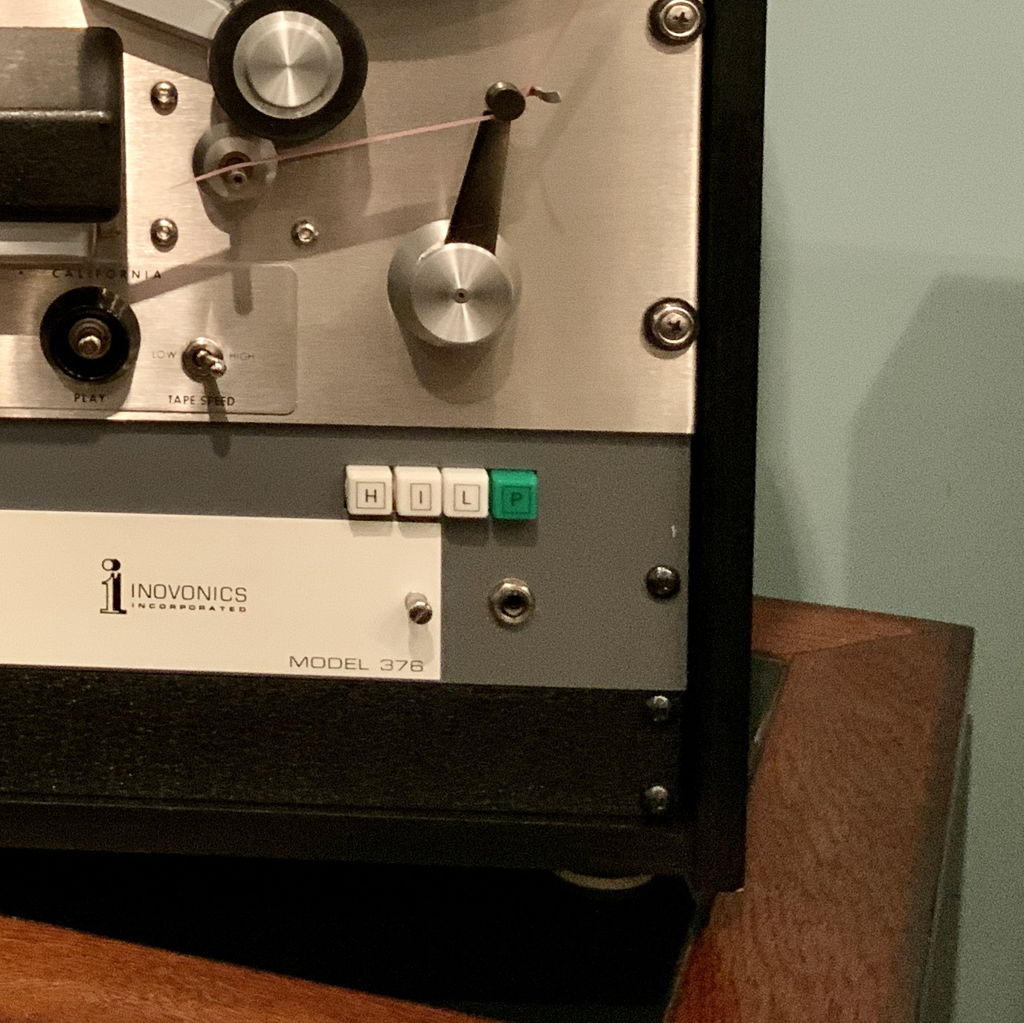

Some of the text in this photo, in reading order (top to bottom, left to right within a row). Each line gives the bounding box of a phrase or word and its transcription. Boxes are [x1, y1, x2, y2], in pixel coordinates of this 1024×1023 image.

[51, 269, 162, 280] CALIFORNIA
[74, 393, 106, 403] PLAY
[168, 395, 236, 407] TAPE SPEED
[365, 489, 377, 503] H
[462, 490, 472, 505] L
[510, 491, 524, 506] P
[131, 583, 248, 603] INOVONICS
[131, 602, 247, 613] INCORPORATED
[289, 655, 424, 673] MODEL 376
